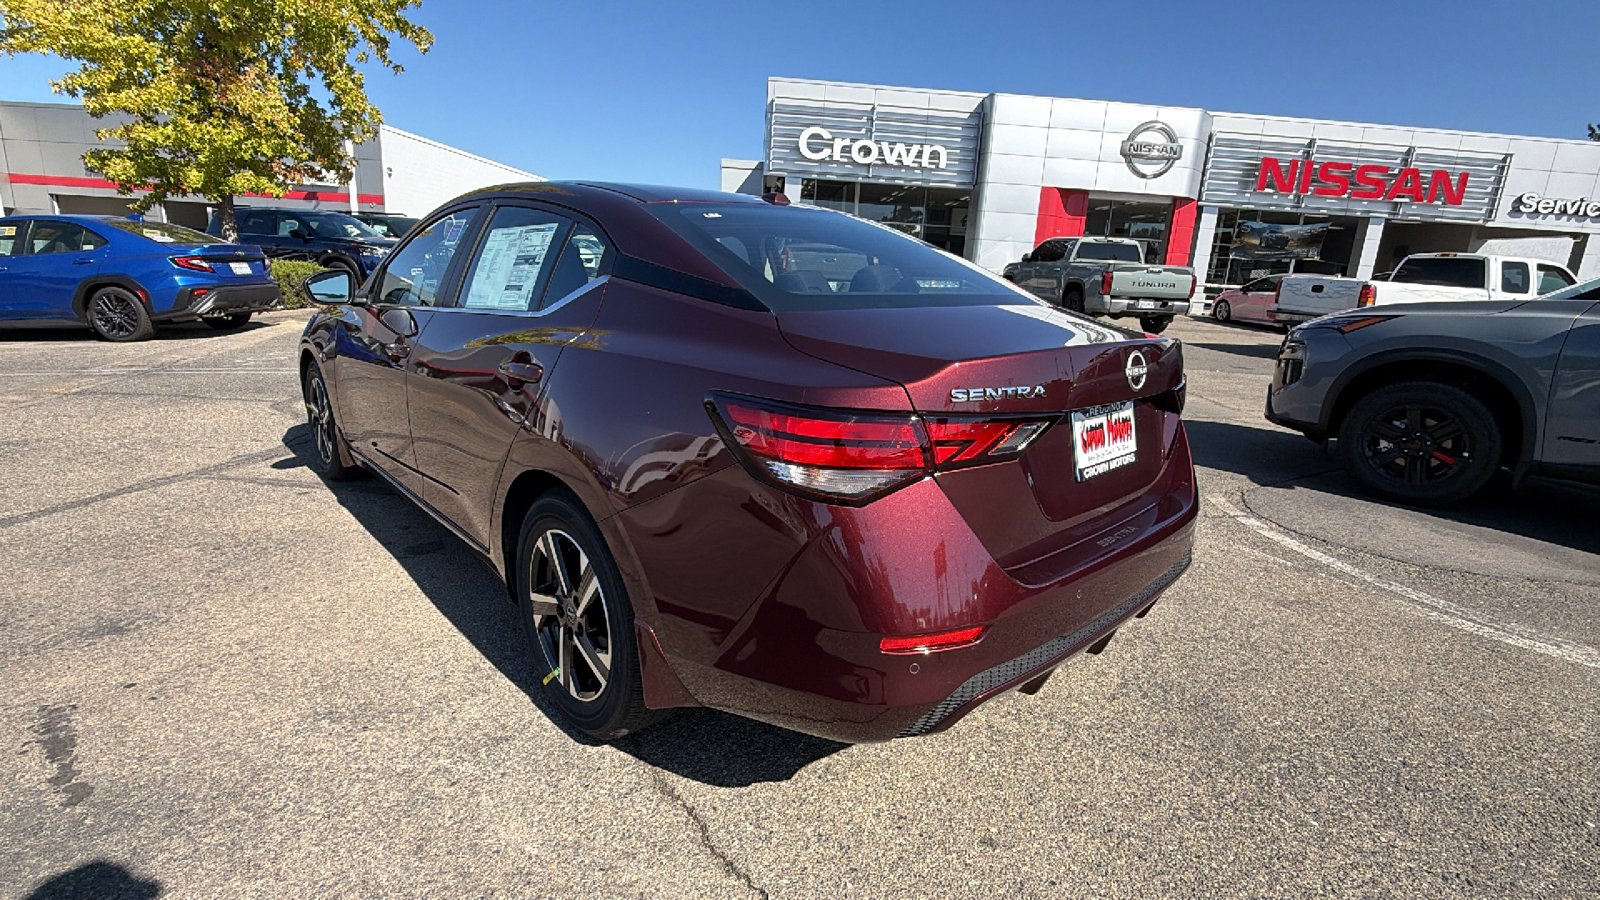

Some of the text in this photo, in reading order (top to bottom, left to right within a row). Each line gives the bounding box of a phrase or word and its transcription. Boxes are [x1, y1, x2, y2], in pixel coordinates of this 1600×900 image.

[799, 126, 947, 169] Crown
[1128, 143, 1178, 156] NISSAN
[1257, 157, 1470, 206] NISSAN
[1131, 281, 1176, 289] TUNDRA
[950, 384, 1047, 403] SENTRA
[1089, 402, 1121, 416] REDDING
[1083, 461, 1109, 478] CROWN
[1110, 453, 1136, 470] MOTORS
